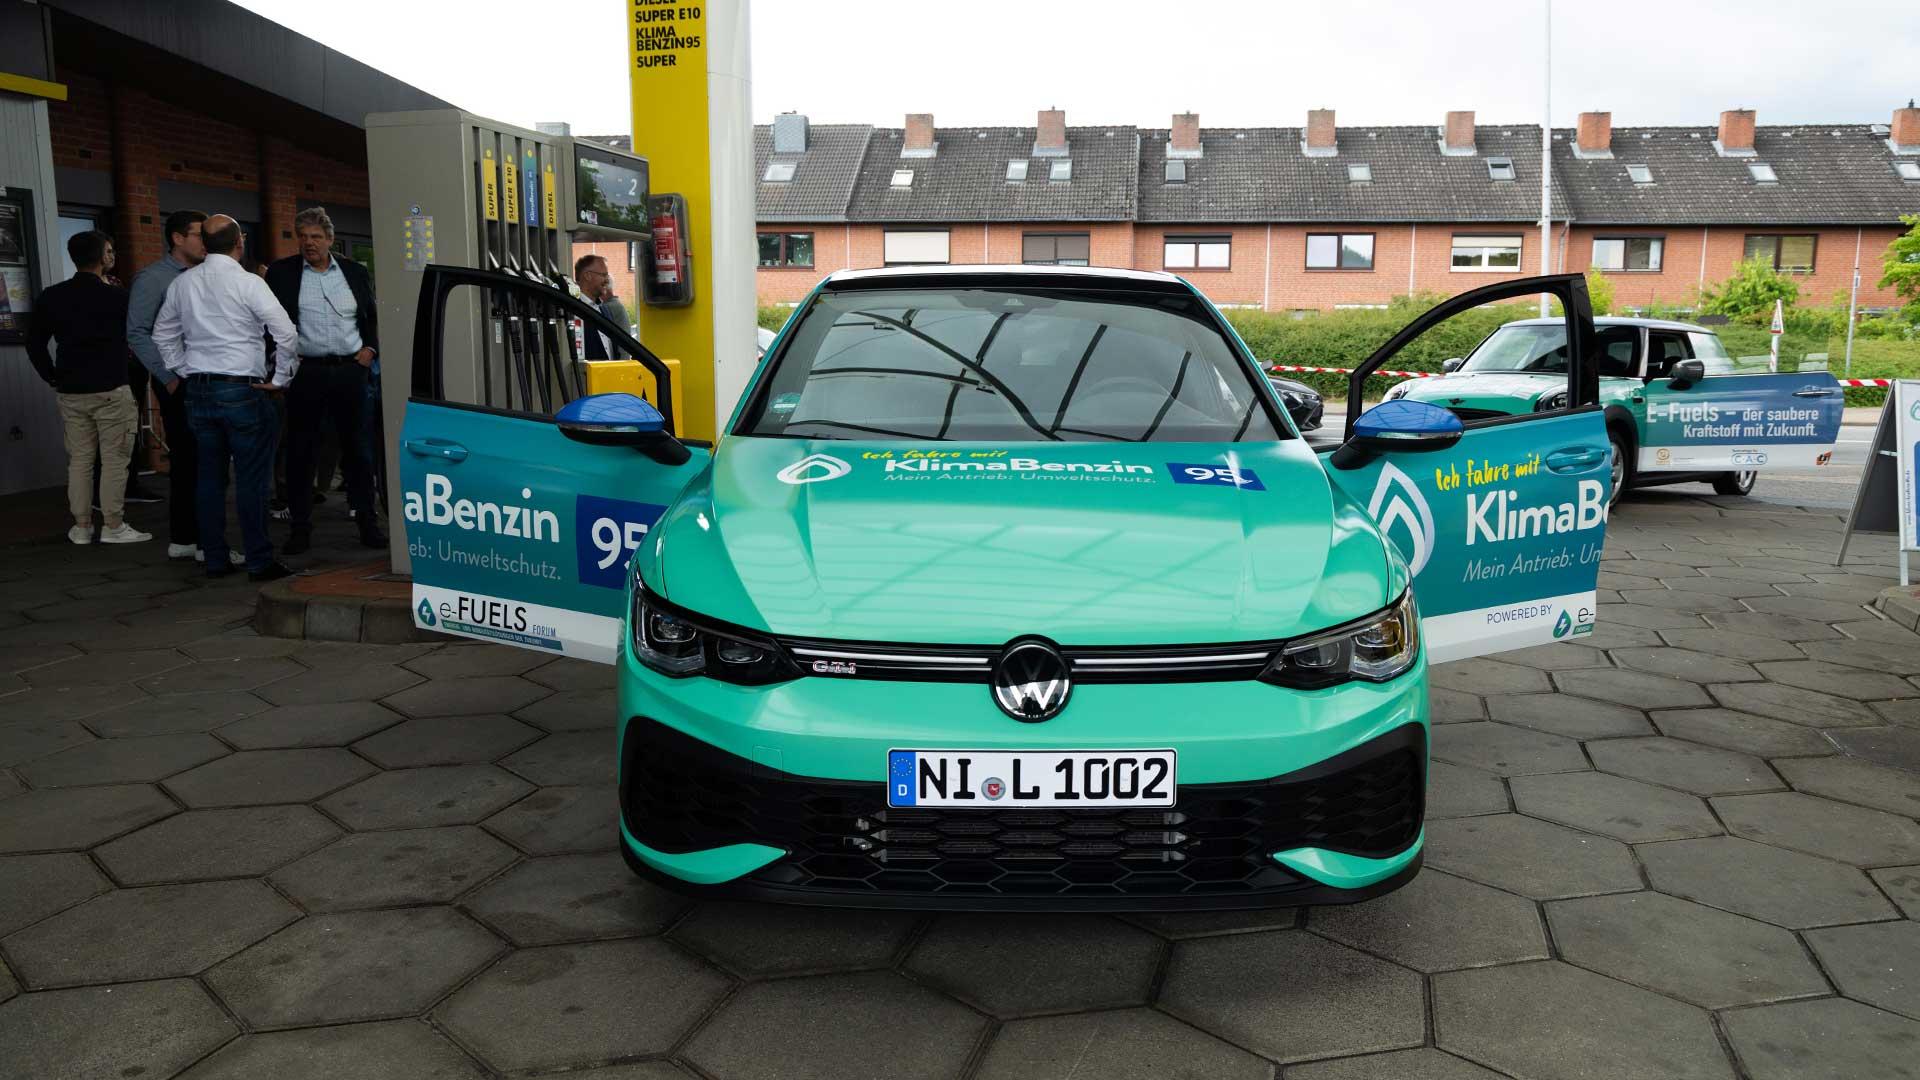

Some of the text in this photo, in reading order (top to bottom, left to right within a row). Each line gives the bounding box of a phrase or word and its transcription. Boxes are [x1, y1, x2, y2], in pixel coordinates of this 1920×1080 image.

[635, 7, 701, 23] SUPER E10
[636, 26, 676, 39] KLIMA
[636, 55, 677, 68] SUPER
[628, 178, 638, 196] 2
[507, 187, 515, 220] SUPER
[1646, 402, 1719, 423] E-Fuels
[1743, 407, 1764, 421] der
[1767, 406, 1820, 421] saubere
[1683, 422, 1818, 438] Kraftstoff mit Zukunft.
[862, 450, 1008, 460] Ich fahre mit
[884, 458, 1154, 474] KlimaBenzin
[1435, 452, 1540, 491] Ich fahre mit
[883, 473, 1157, 484] Mein Antrieb: Umweltschutz.
[1184, 467, 1254, 484] 95
[404, 474, 560, 543] aBenzin
[591, 517, 648, 570] 95
[409, 536, 561, 580] eb: Umweltschutz.
[1462, 557, 1505, 583] Mein
[1508, 548, 1574, 577] Antrieb:
[440, 596, 527, 632] e-FUELS
[532, 624, 557, 637] FORUM
[1487, 603, 1553, 624] POWERED BY
[812, 660, 857, 674] GTI
[919, 758, 1169, 800] NI L 1002
[897, 783, 909, 798] D
